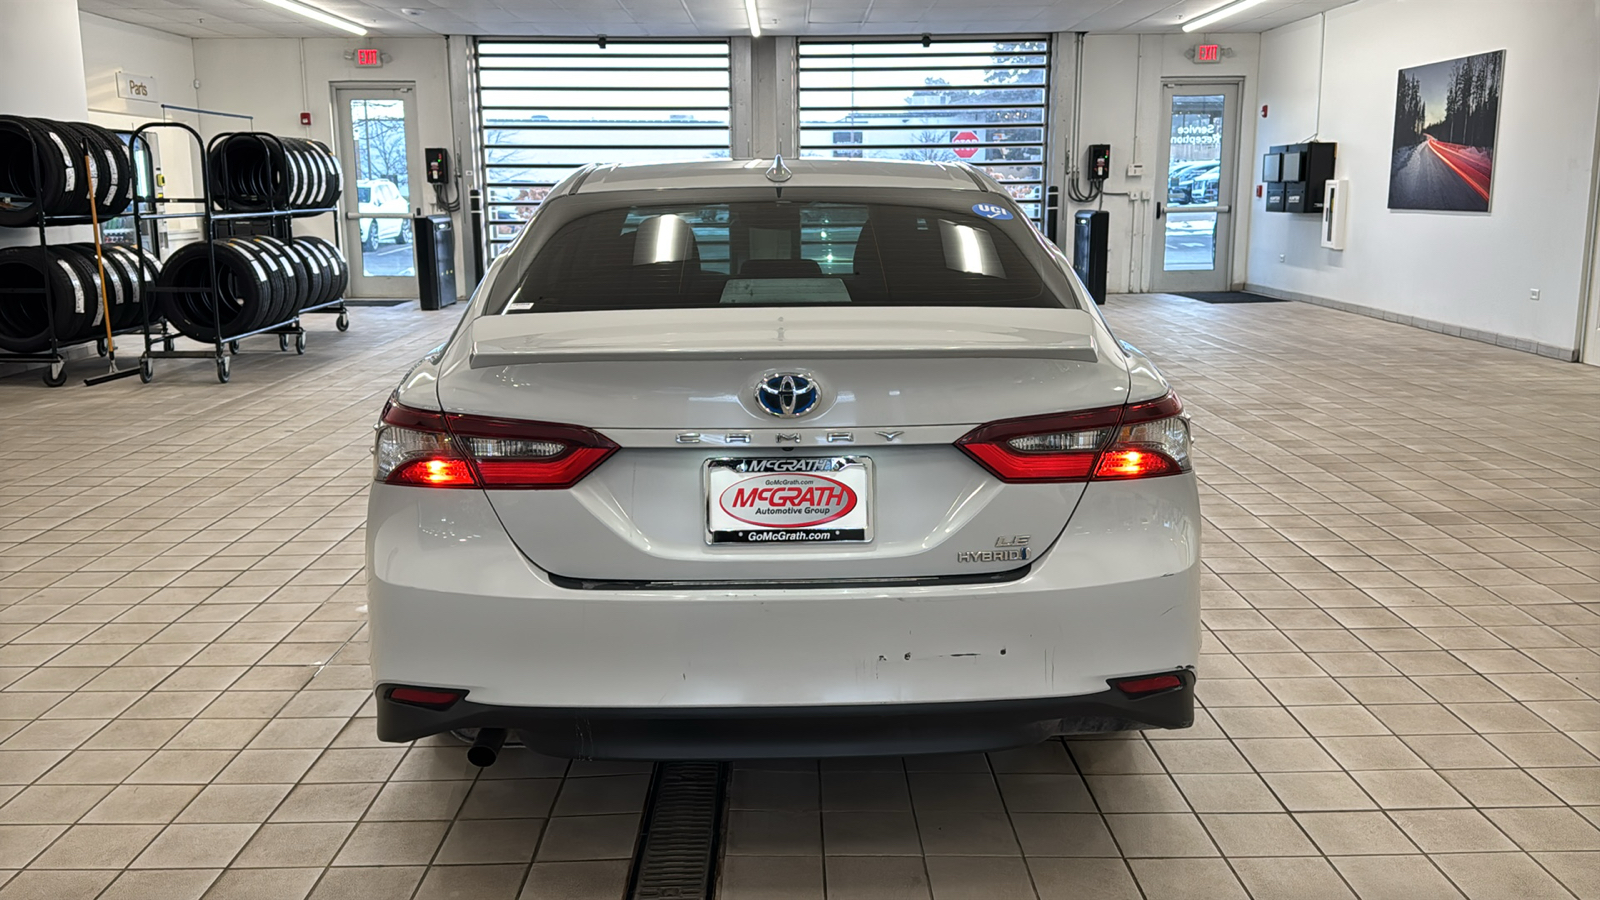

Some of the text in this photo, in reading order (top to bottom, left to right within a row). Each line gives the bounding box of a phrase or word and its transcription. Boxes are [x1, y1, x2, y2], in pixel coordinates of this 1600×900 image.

[358, 49, 377, 65] EXIT
[1199, 45, 1218, 60] EXIT
[129, 79, 148, 96] Parts
[676, 431, 904, 443] CAMRY
[755, 507, 830, 516] Automotive Group
[748, 531, 831, 541] GoMcGrath.com
[995, 535, 1030, 547] LE
[958, 550, 1019, 562] HYBRID
